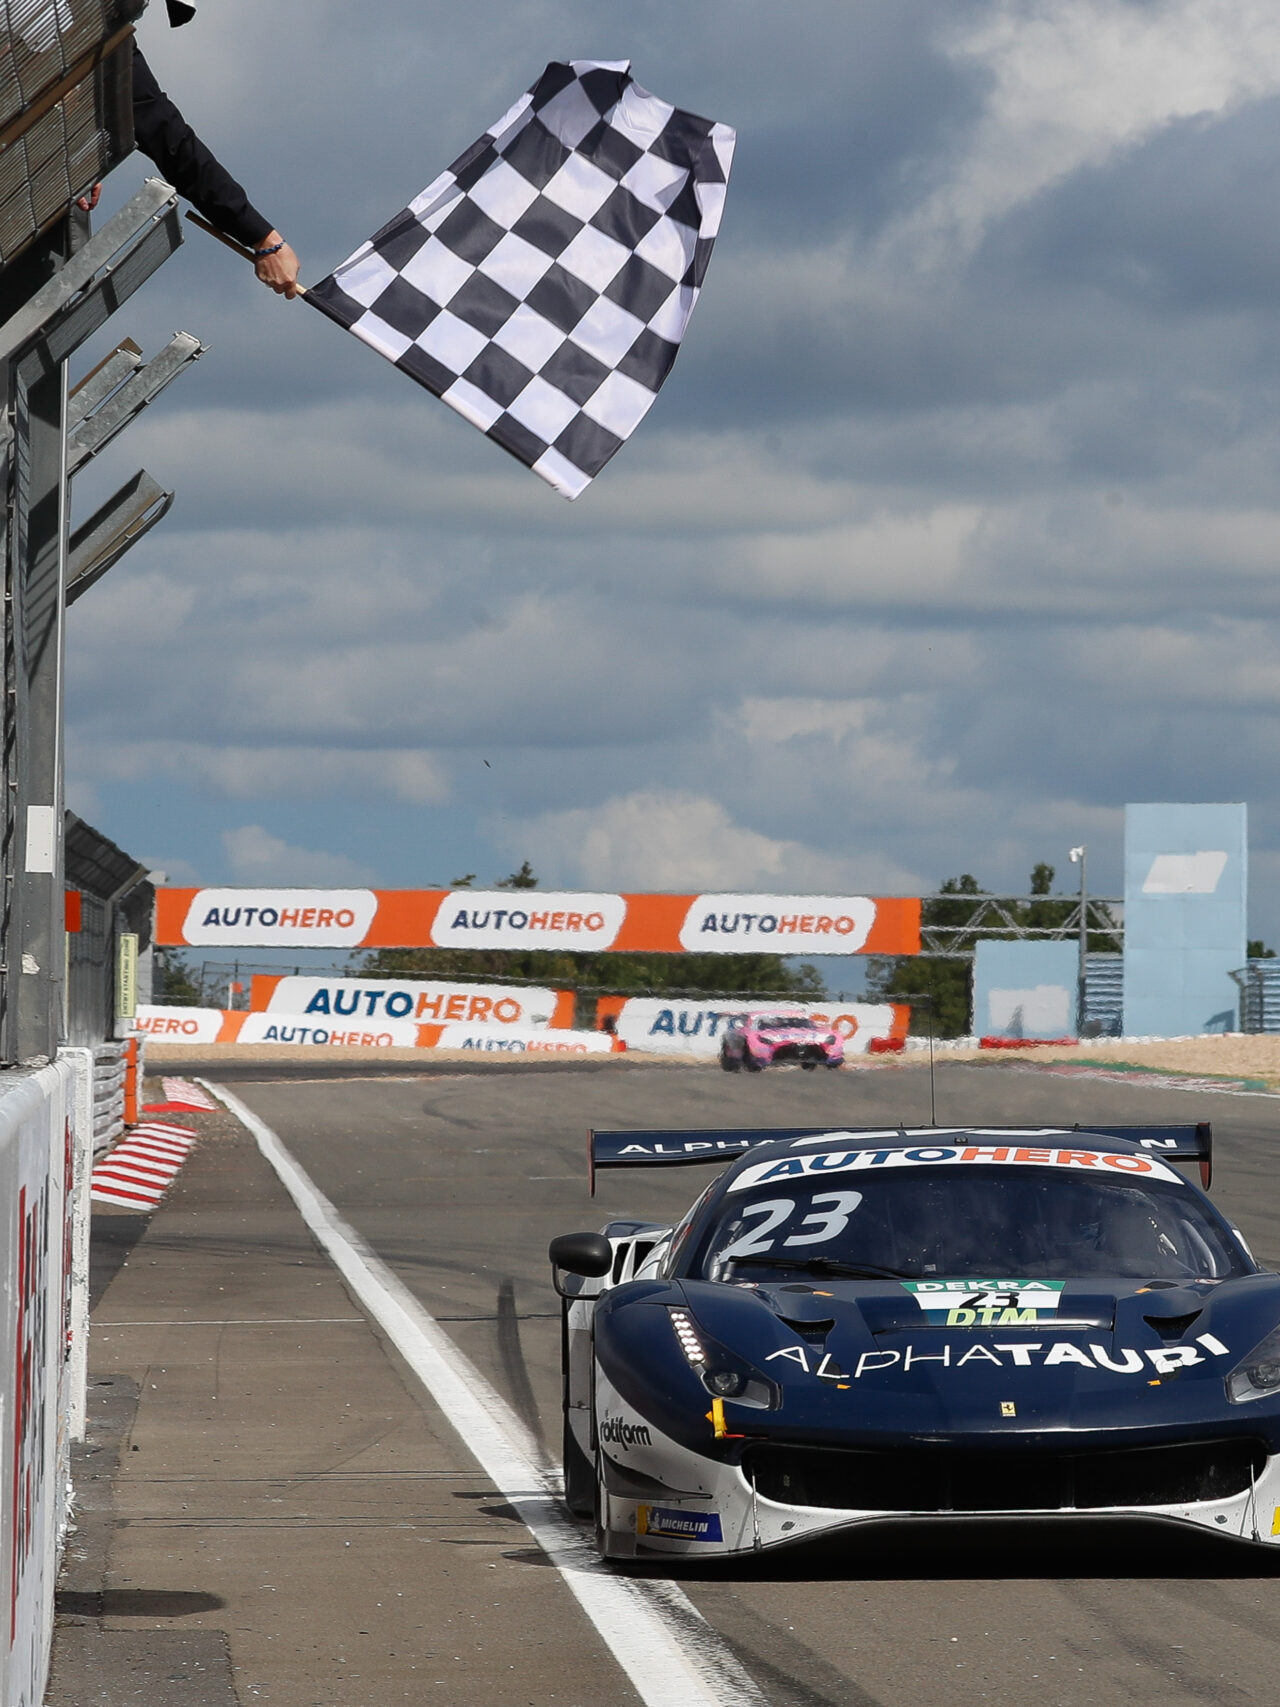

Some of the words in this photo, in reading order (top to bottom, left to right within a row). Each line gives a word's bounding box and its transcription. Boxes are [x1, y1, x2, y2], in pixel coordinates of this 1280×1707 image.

[203, 907, 355, 928] AUTOHERO
[450, 909, 605, 932] AUTOHERO
[701, 913, 855, 935] AUTOHERO
[305, 988, 521, 1023] AUTOHERO
[263, 1025, 393, 1047] AUTOHERO
[754, 1147, 1152, 1182] AUTOHERO
[718, 1191, 864, 1263] 23
[916, 1281, 1052, 1292] DEKRA
[959, 1291, 1020, 1308] 23
[946, 1308, 1038, 1326] DTM
[765, 1332, 1230, 1380] ALPHATAURI
[600, 1416, 652, 1451] rotiform
[661, 1518, 708, 1533] MICHELIN
